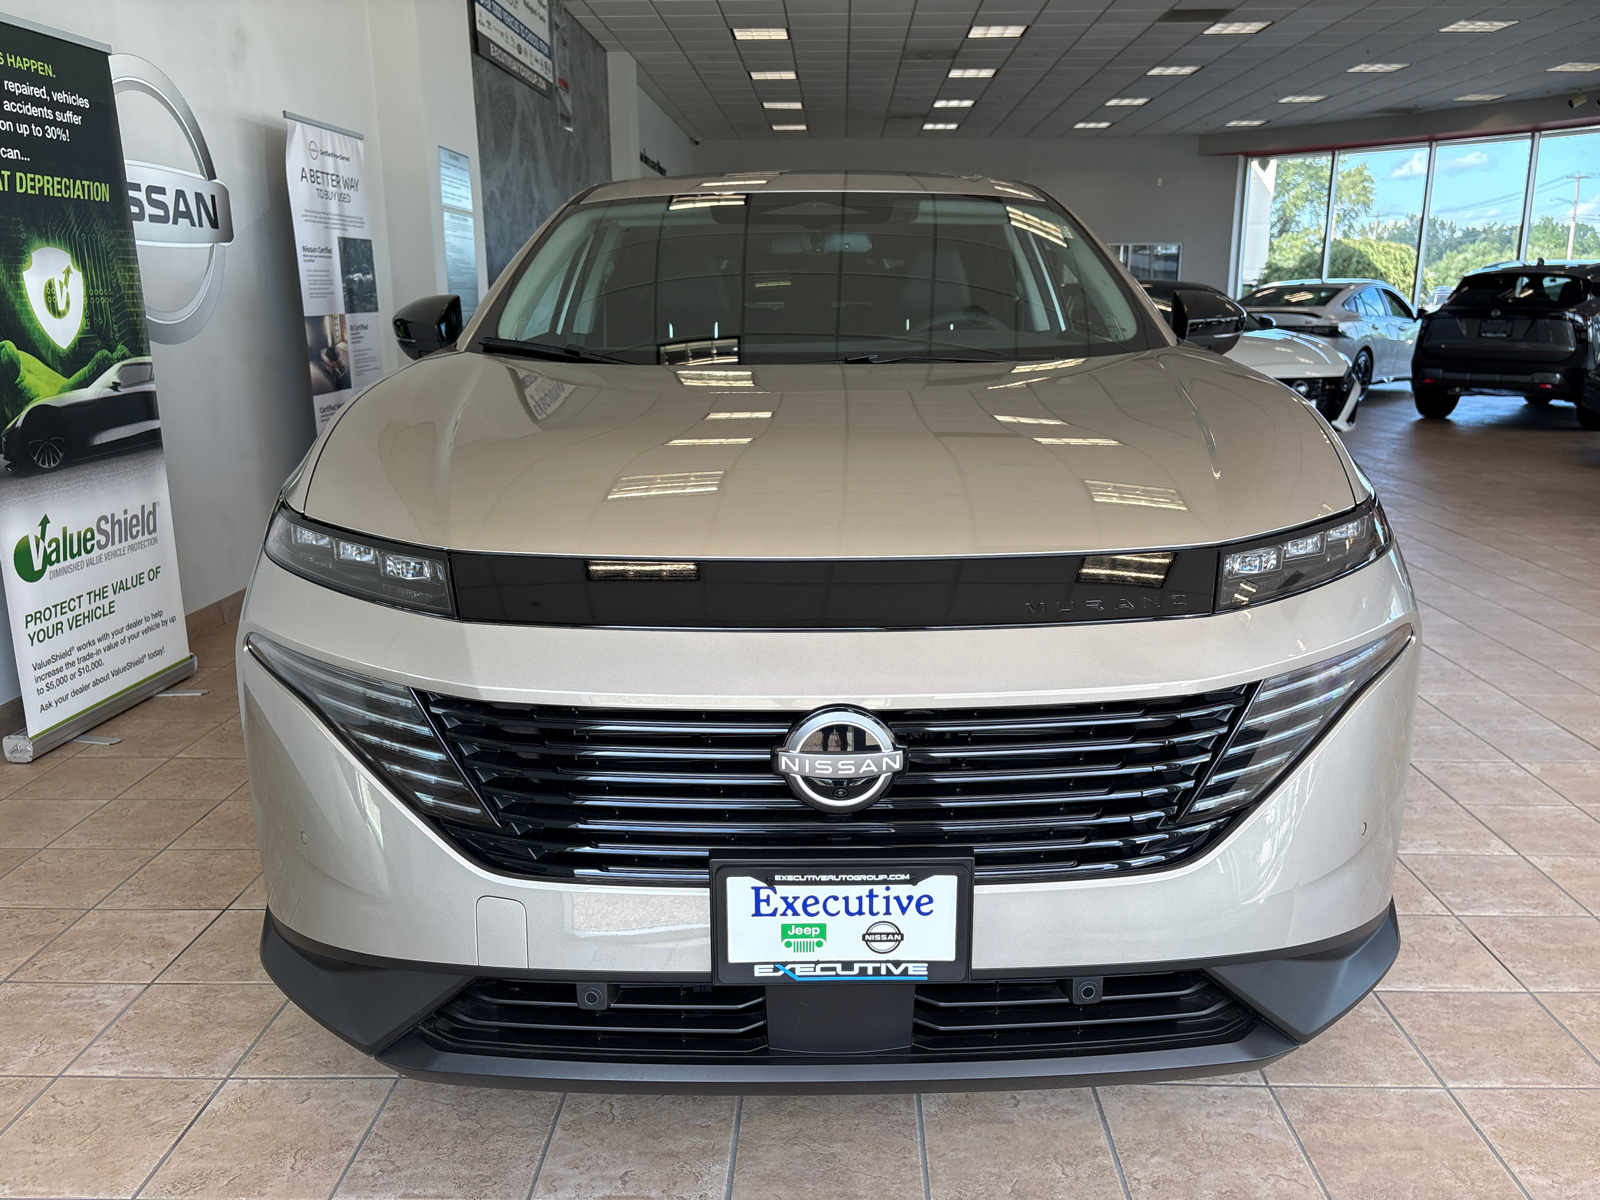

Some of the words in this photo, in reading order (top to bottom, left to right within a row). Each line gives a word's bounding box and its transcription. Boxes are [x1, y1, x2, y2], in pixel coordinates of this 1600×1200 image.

[6, 53, 56, 78] HAPPEN.
[4, 79, 50, 102] repaired,
[51, 90, 90, 109] vehicles
[3, 99, 54, 120] accidents
[55, 110, 83, 126] suffer
[16, 122, 30, 138] up
[31, 123, 43, 137] to
[44, 125, 71, 142] 30%!
[0, 147, 31, 162] can...
[15, 171, 110, 203] DEPRECIATION
[300, 167, 309, 183] A
[309, 168, 342, 190] BETTER
[342, 175, 360, 192] WAY
[316, 188, 325, 200] TO
[324, 189, 337, 202] BUY
[337, 192, 352, 204] USED
[49, 560, 85, 581] DIMINISHED
[85, 554, 103, 568] VALUE
[104, 547, 127, 562] VEHICLE
[127, 536, 158, 554] PROTECTION
[24, 594, 84, 629] PROTECT
[86, 585, 109, 605] THE
[111, 571, 146, 596] VALUE
[147, 565, 162, 582] OF
[1024, 593, 1189, 615] MURANO
[27, 621, 64, 647] YOUR
[67, 600, 116, 631] VEHICLE
[76, 638, 96, 653] works
[97, 632, 111, 644] with
[111, 626, 125, 640] your
[125, 618, 144, 632] dealer
[144, 615, 151, 623] to
[151, 609, 164, 621] help
[34, 665, 64, 684] increase
[64, 660, 76, 671] the
[77, 648, 102, 665] trade-in
[102, 640, 120, 653] value
[120, 635, 127, 646] of
[127, 631, 140, 645] your
[141, 622, 161, 636] vehicle
[161, 618, 169, 628] by
[169, 615, 177, 624] up
[36, 687, 45, 696] to
[45, 674, 69, 692] $5,000
[69, 672, 77, 681] or
[77, 658, 105, 677] $10,000.
[39, 700, 54, 713] Ask
[53, 692, 70, 708] your
[70, 682, 91, 698] dealer
[91, 673, 110, 688] about
[148, 645, 166, 661] today!
[781, 754, 901, 775] NISSAN
[774, 873, 911, 882] EXECUTIVEAUTOGROUP.COM
[750, 885, 934, 918] Executive
[787, 923, 821, 937] Jeep
[864, 933, 902, 941] NISSAN
[753, 962, 929, 979] EXECUTIVE
